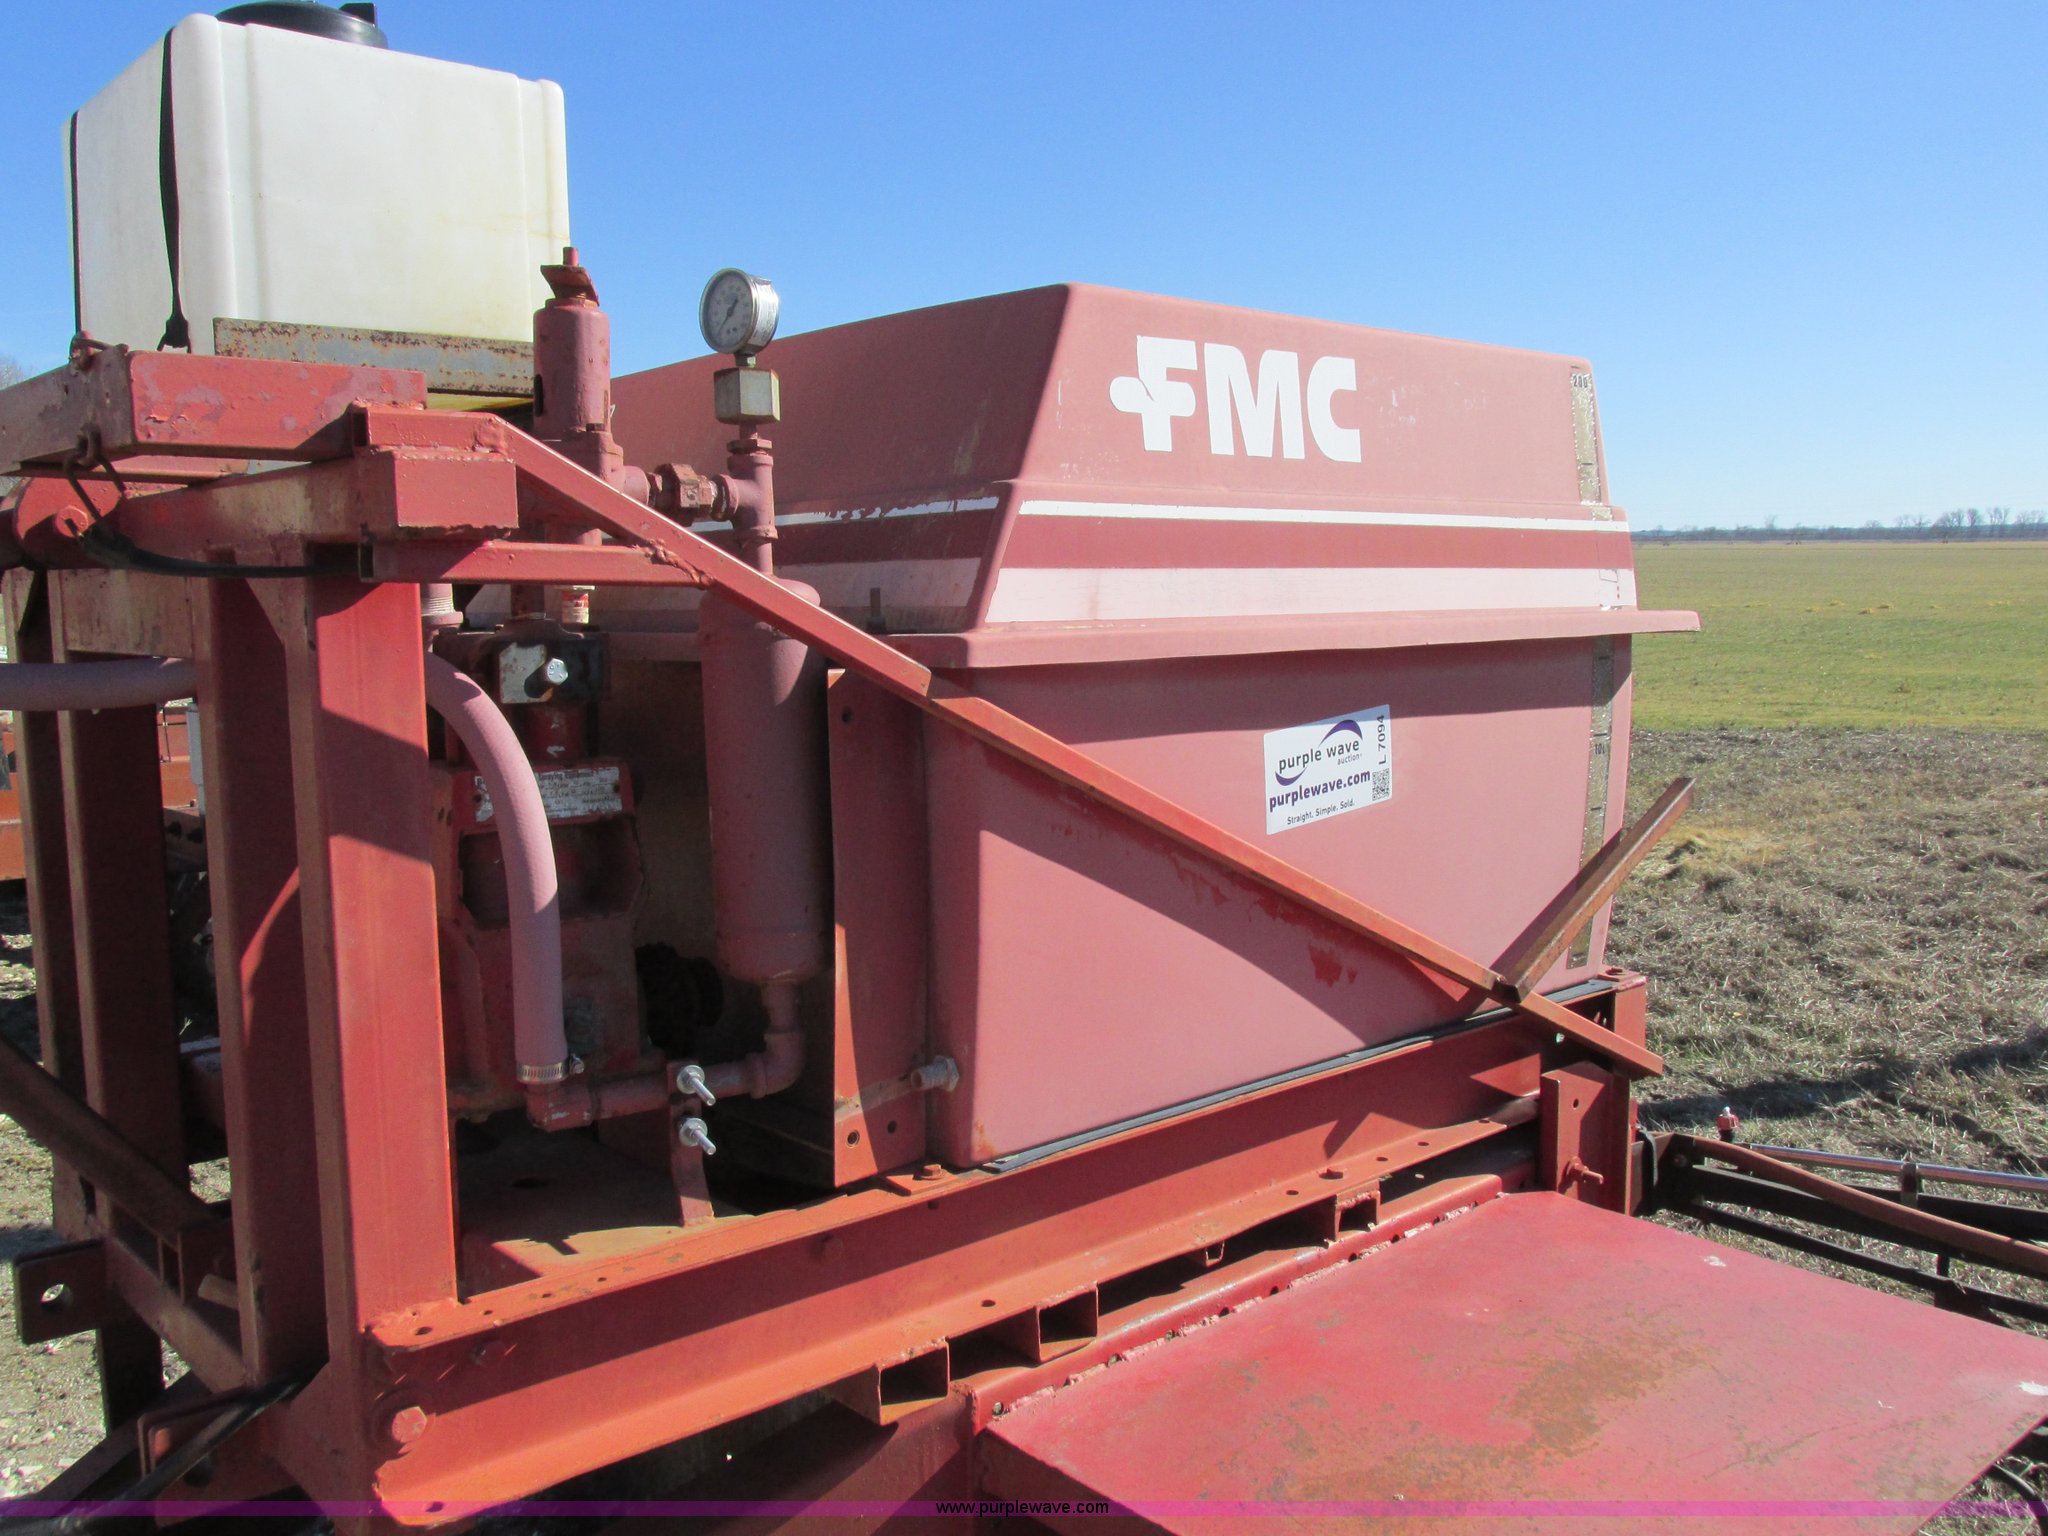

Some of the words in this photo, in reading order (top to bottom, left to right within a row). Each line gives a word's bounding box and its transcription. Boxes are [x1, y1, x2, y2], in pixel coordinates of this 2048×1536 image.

[1109, 335, 1362, 463] FMC
[1376, 715, 1387, 752] 7094
[1278, 748, 1322, 774] purple
[1326, 739, 1360, 759] wave
[1337, 753, 1360, 766] auction
[1378, 754, 1387, 765] L
[1269, 770, 1371, 813] purplewave.com
[1286, 810, 1314, 826] Straight.
[1315, 804, 1339, 817] Simple.
[1340, 798, 1355, 810] Sold.
